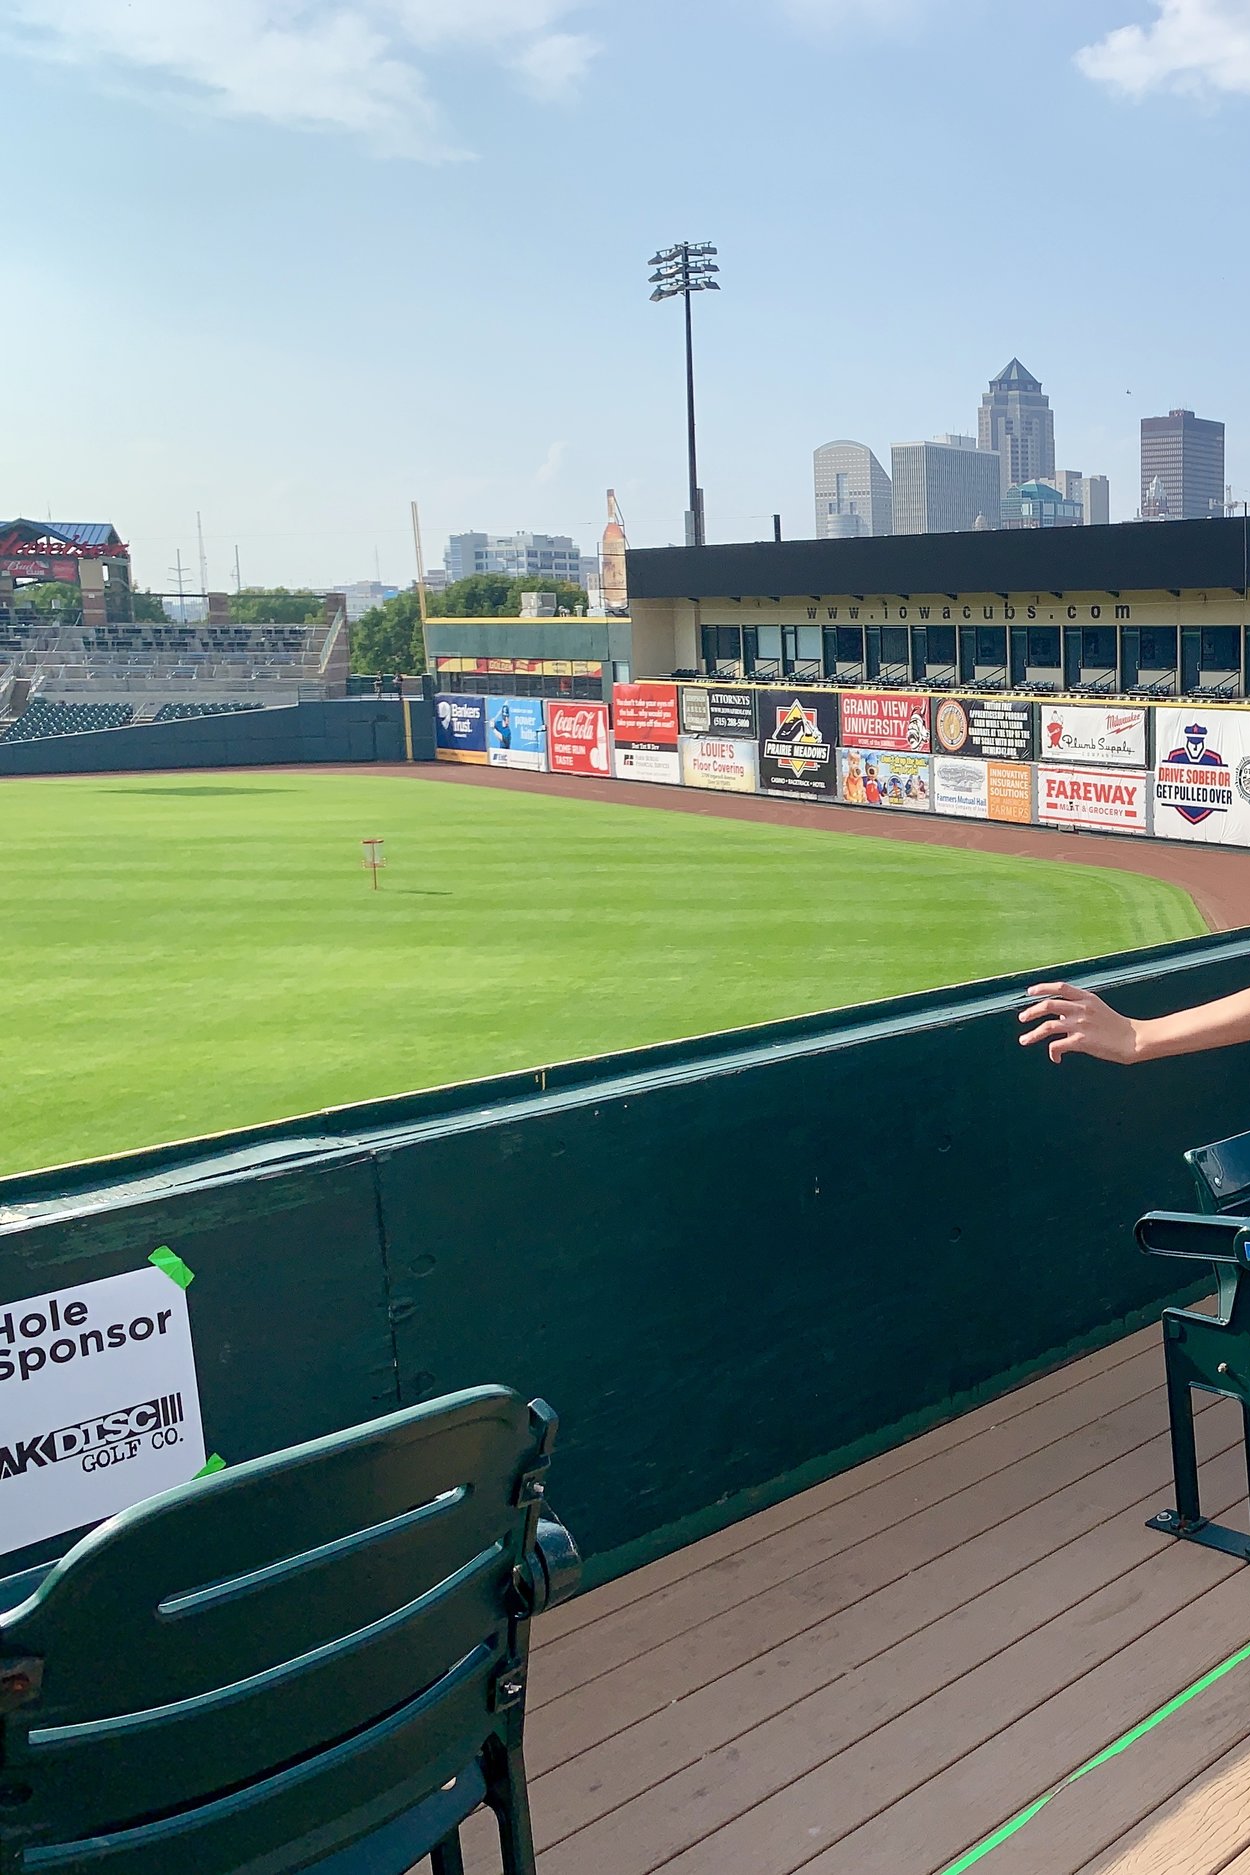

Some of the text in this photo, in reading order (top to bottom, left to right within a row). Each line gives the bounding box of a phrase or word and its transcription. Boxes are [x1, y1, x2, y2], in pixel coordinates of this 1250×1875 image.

[807, 602, 1131, 620] www.iowacubs.com
[711, 694, 750, 706] ATTORNEYS
[843, 698, 908, 718] GRAND VIEW
[451, 703, 480, 718] Bankers
[844, 717, 907, 737] UNIVERSITY
[1105, 712, 1142, 730] Milwaukee
[554, 743, 586, 755] HOME RUN
[701, 742, 734, 759] LOUIE'S
[767, 743, 827, 759] PRAIRIE MEADOWS
[1062, 734, 1135, 755] Plumb Supply
[555, 755, 574, 766] TASTE
[693, 758, 744, 777] Floor Covering
[990, 768, 1028, 780] INNOVATIVE
[1158, 767, 1231, 787] DRIVE SOBER OR
[990, 778, 1029, 790] INSURANCE
[936, 793, 986, 806] Farmers Mutual Hail
[990, 787, 1029, 800] SOLUTIONS
[1046, 779, 1137, 806] FAREWAY
[1156, 784, 1233, 805] GET PULLED OVER
[990, 805, 1029, 819] FARMERS
[1088, 806, 1124, 817] GROCERY
[82, 1427, 184, 1473] GOLF CO.
